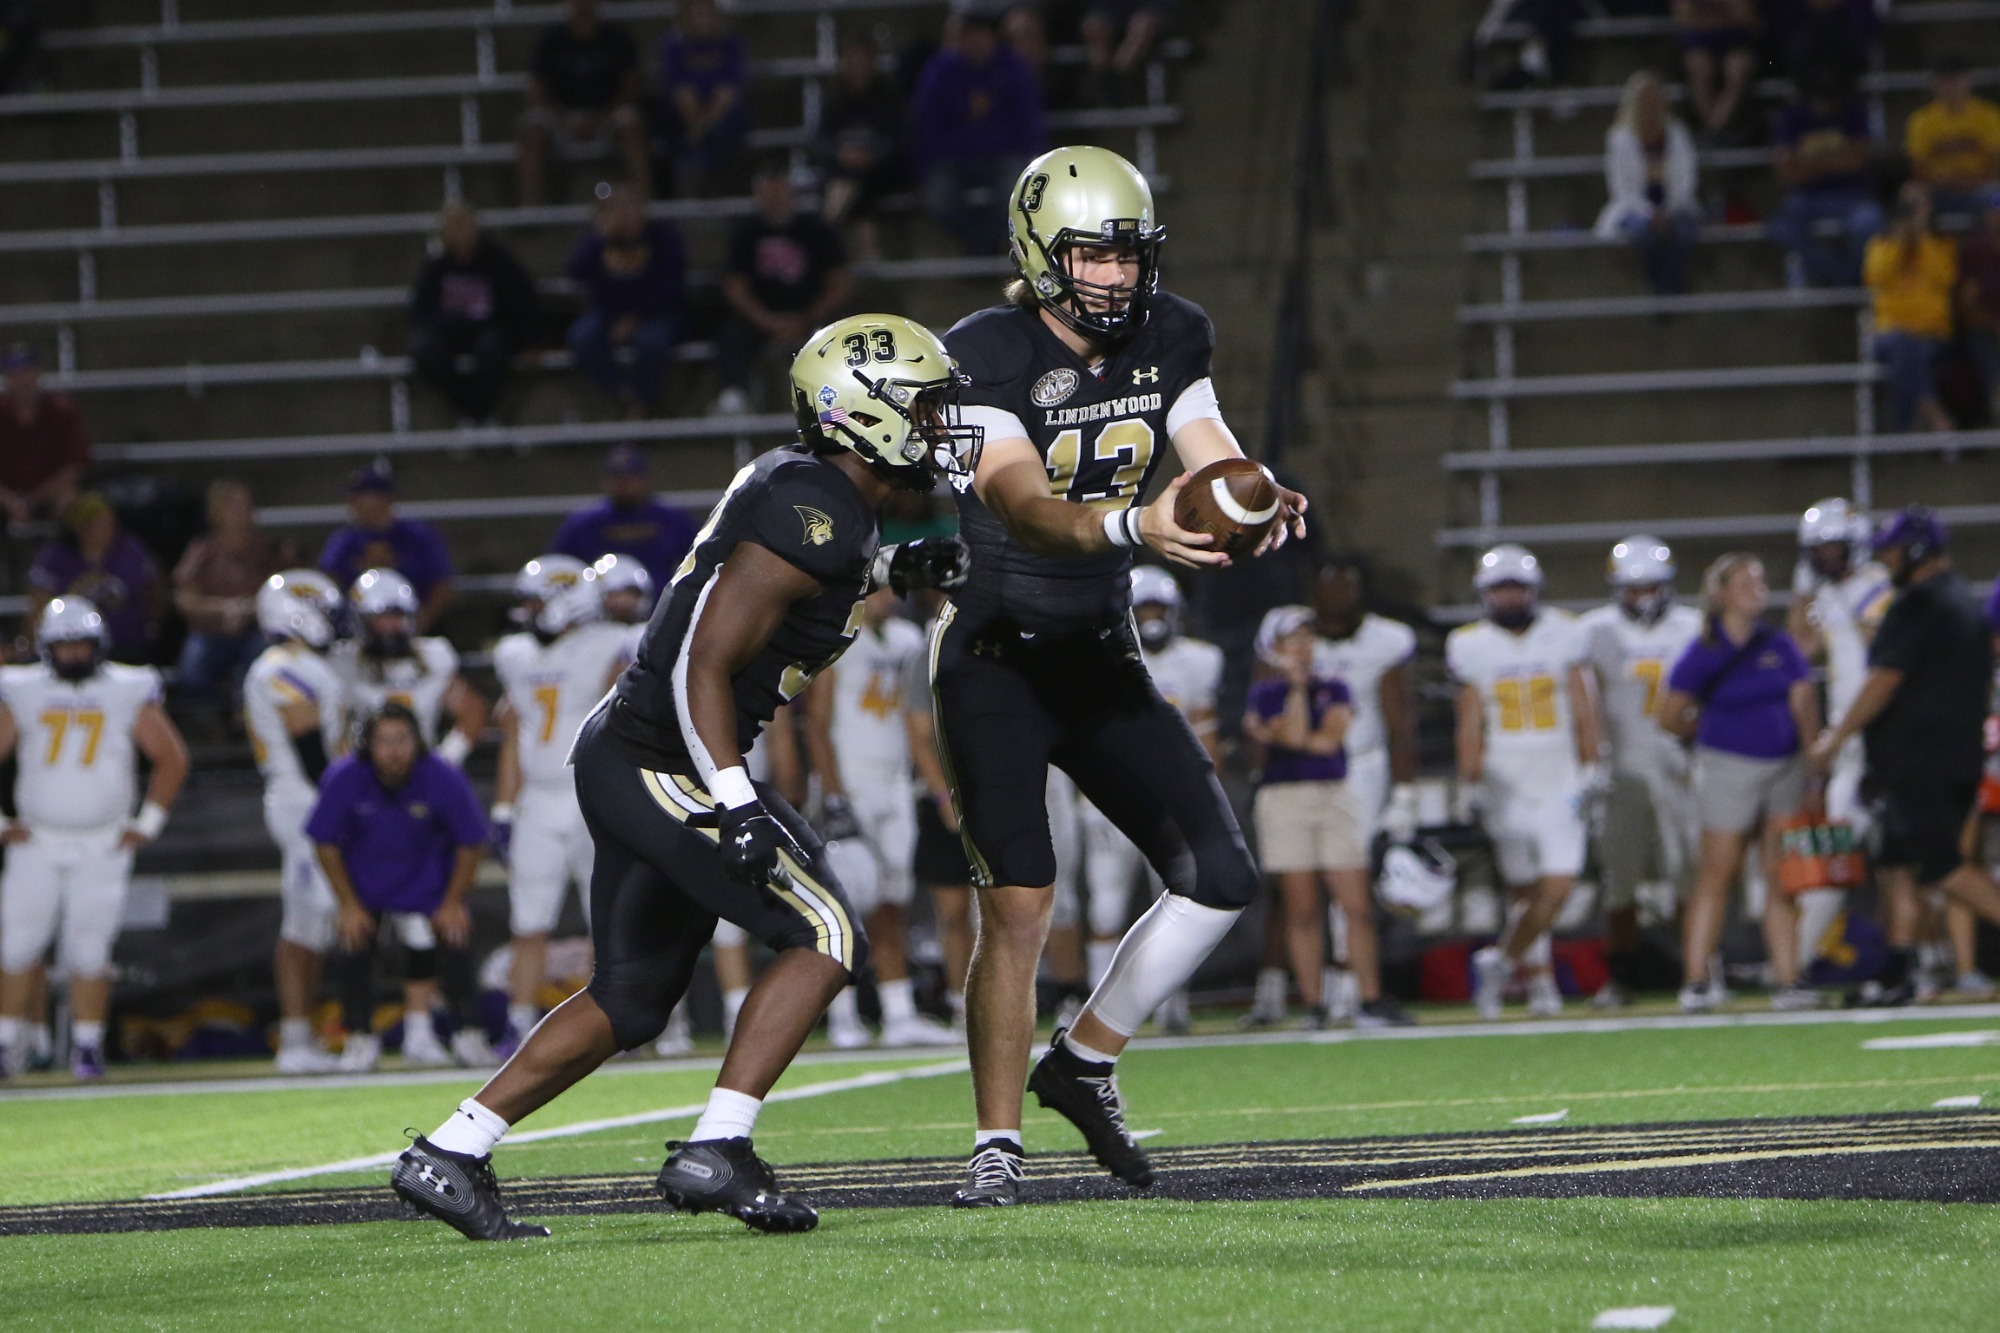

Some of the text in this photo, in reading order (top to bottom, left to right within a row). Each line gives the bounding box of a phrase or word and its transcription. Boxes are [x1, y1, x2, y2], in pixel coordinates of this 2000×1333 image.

[1017, 172, 1050, 212] 13
[842, 329, 897, 369] 33
[1045, 393, 1162, 426] LINDENWOOD
[1045, 417, 1155, 510] 13
[38, 709, 104, 767] 77
[532, 687, 560, 743] 7
